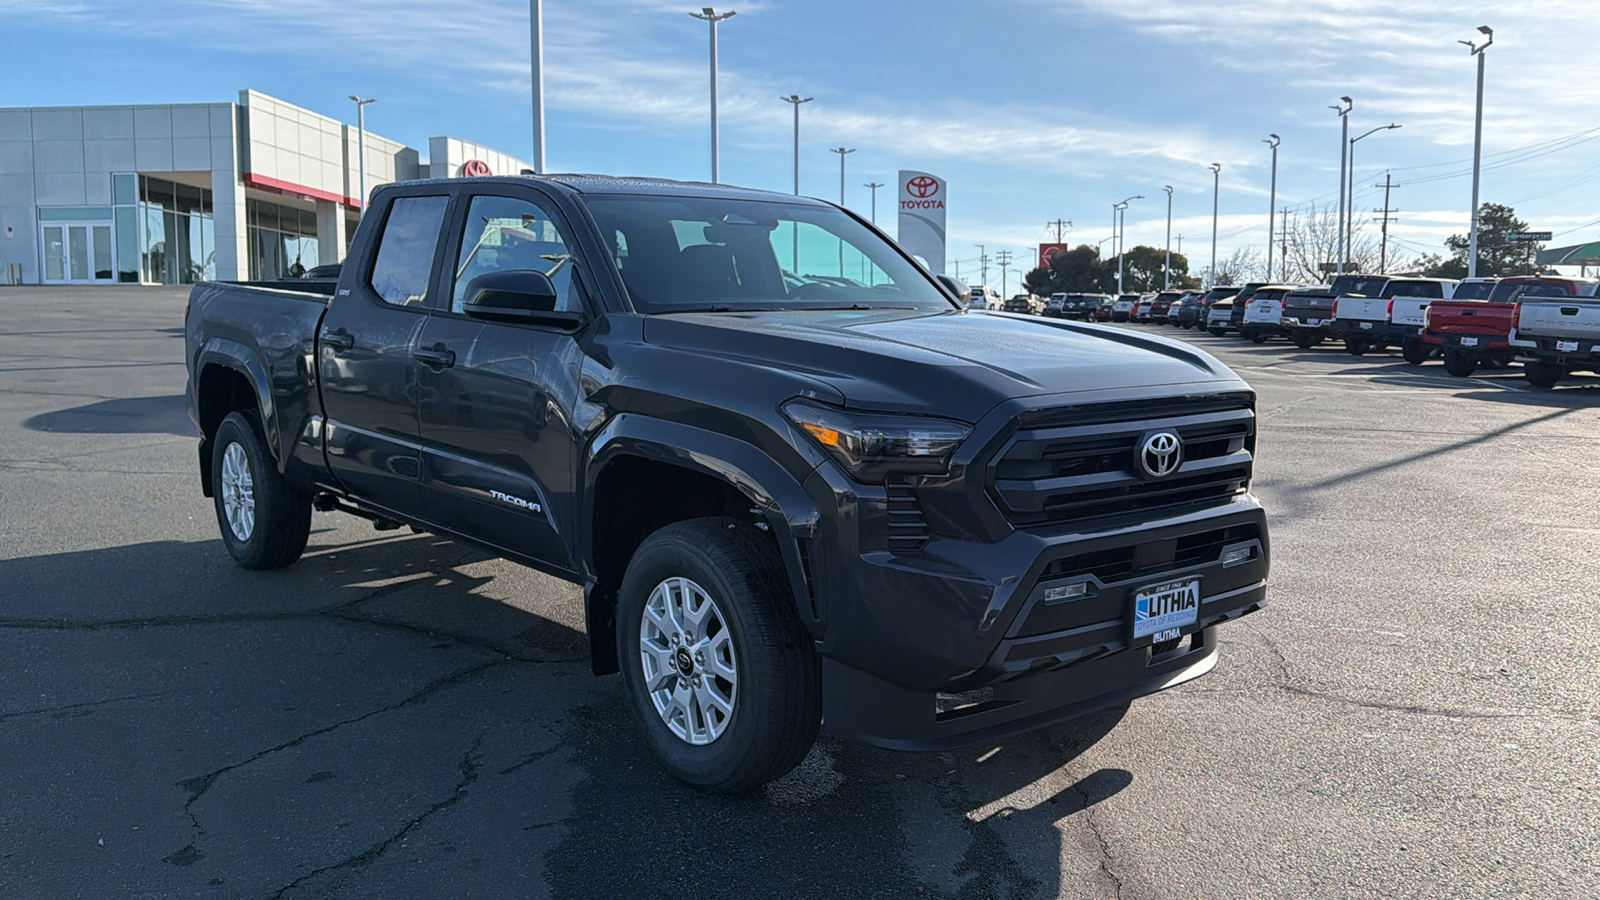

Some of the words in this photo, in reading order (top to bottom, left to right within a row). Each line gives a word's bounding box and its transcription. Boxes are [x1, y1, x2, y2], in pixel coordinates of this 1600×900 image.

[900, 200, 944, 209] TOYOTA
[490, 489, 541, 512] TACOMA
[1149, 588, 1195, 618] LITHIA
[1135, 620, 1156, 631] TOYOTA
[1158, 615, 1166, 625] OF
[1168, 609, 1195, 622] REDDING
[1159, 627, 1180, 640] LITHIA
